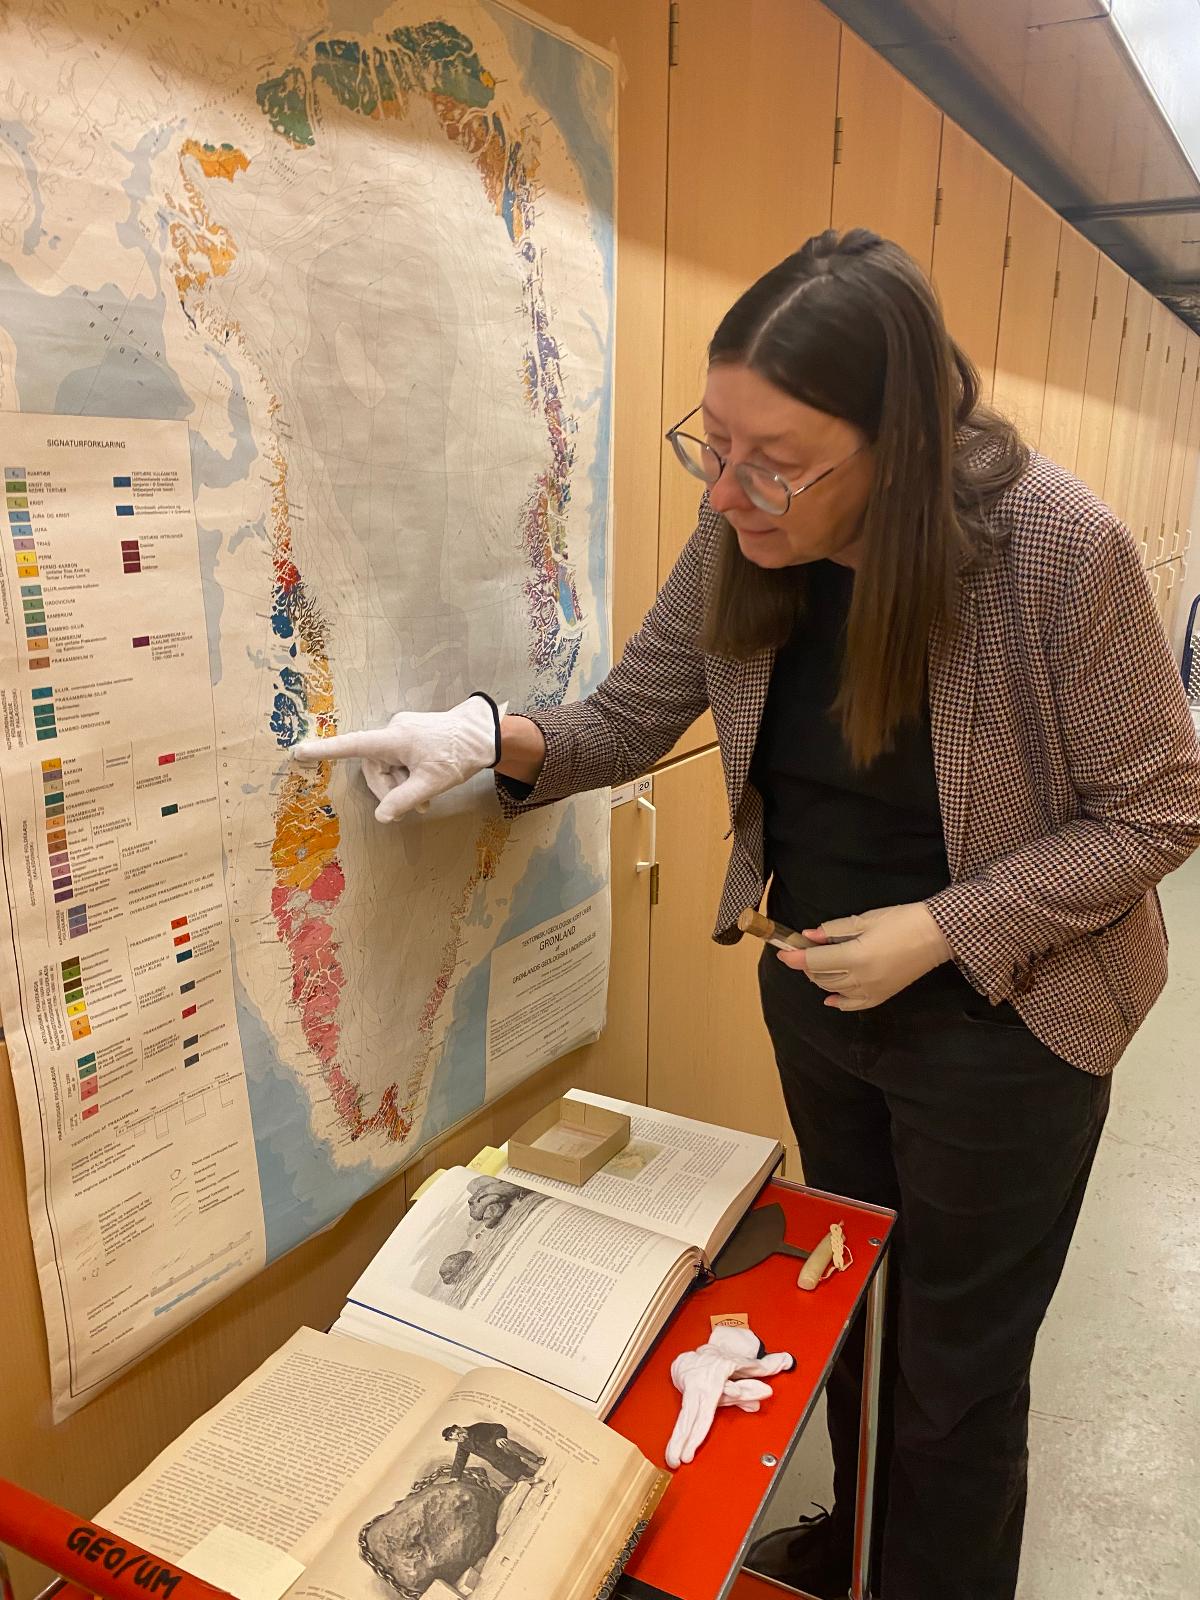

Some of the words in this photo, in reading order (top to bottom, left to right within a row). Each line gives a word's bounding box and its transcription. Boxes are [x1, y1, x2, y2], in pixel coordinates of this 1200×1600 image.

[47, 439, 126, 449] SIGNATURFORKLARING
[639, 781, 650, 791] 20
[66, 1526, 183, 1600] GEO/UM
